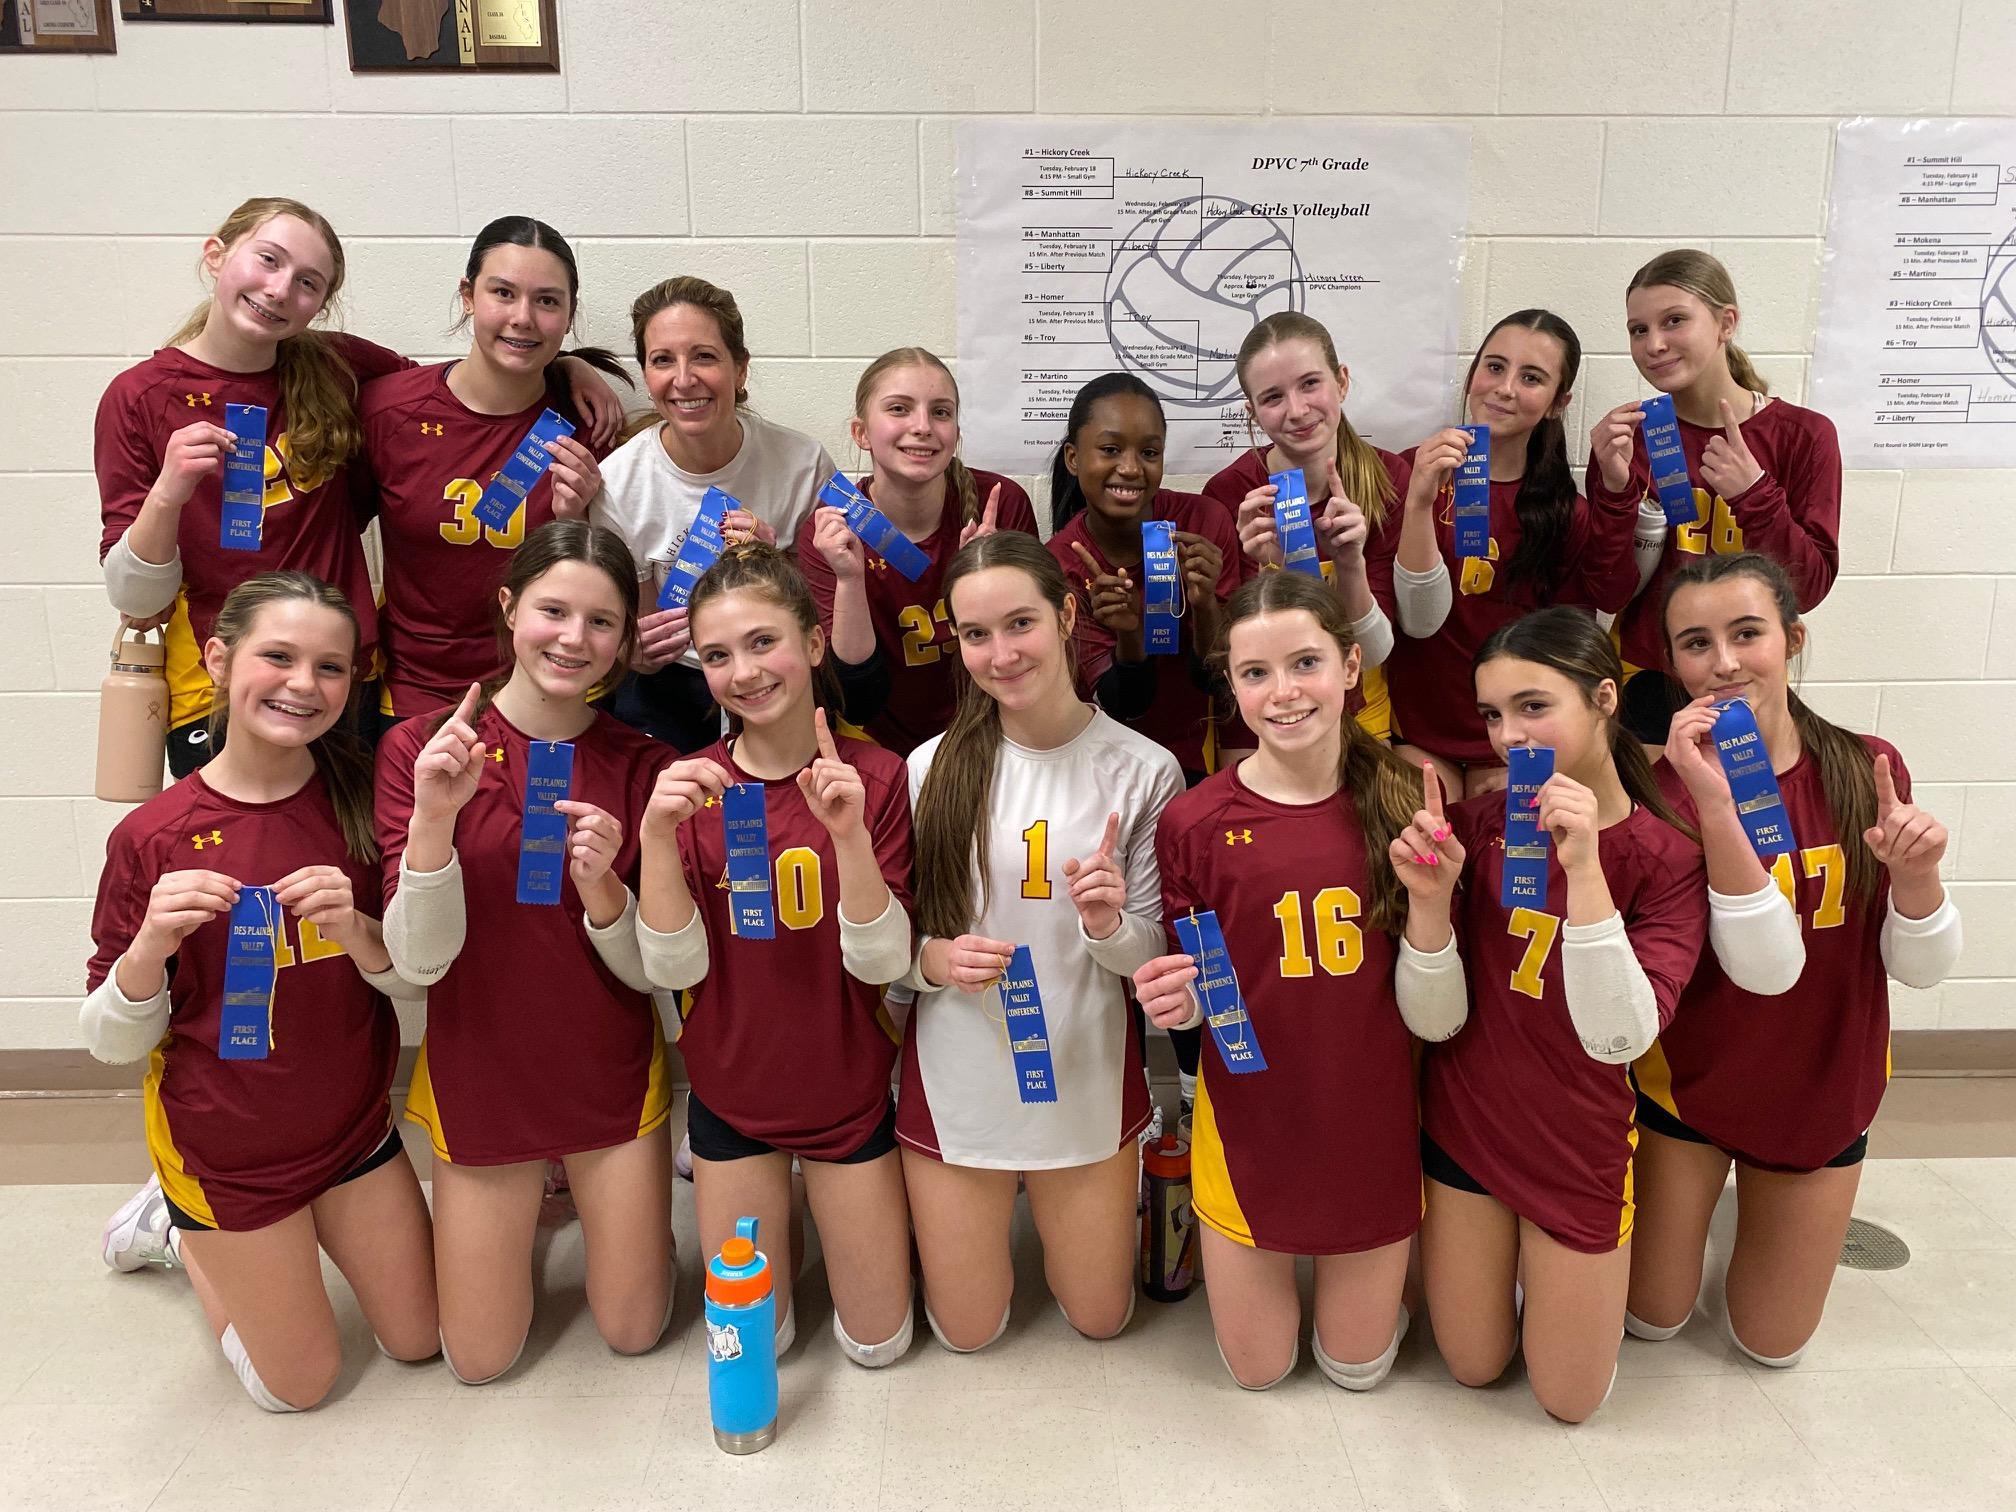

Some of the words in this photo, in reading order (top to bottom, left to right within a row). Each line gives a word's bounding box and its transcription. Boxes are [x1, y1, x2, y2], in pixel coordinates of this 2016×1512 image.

[1251, 157, 1297, 171] DPVC
[1300, 157, 1318, 171] 7th
[1322, 157, 1369, 171] Grade
[1250, 203, 1288, 218] Girls
[1292, 203, 1370, 218] Volleyball
[1024, 334, 1033, 342] #6
[1040, 334, 1056, 342] Troy
[1647, 428, 1656, 437] DES
[1656, 423, 1676, 435] PLAINES
[1655, 435, 1672, 446] VALLEY
[528, 446, 545, 460] VALLEY
[1651, 446, 1680, 459] CONFERENCE
[516, 451, 542, 473] CONFERENCE
[1467, 454, 1487, 463] PLAINES
[1463, 466, 1481, 475] VALLEY
[1457, 478, 1487, 486] CONFERENCE
[489, 497, 506, 512] FIRST
[231, 519, 252, 528] FIRST
[1280, 519, 1309, 532] CONFERENCE
[1676, 487, 1745, 556] 26
[230, 528, 252, 538] PLACE
[1153, 563, 1169, 571] VALLEY
[1459, 537, 1499, 596] 6
[672, 584, 690, 596] FIRST
[1153, 628, 1170, 636] FIRST
[1152, 636, 1171, 644] PLACE
[1719, 738, 1732, 751] DES
[1732, 731, 1758, 747] PLAINES
[1731, 749, 1755, 762] VALLEY
[1729, 760, 1768, 779] CONFERENCE
[530, 777, 542, 787] DES
[543, 778, 568, 788] PLAINES
[1511, 783, 1523, 793] DES
[537, 791, 558, 801] VALLEY
[727, 820, 739, 829] DES
[739, 818, 763, 829] PLAINES
[1755, 824, 1779, 836] FIRST
[736, 834, 757, 843] VALLEY
[1757, 833, 1783, 845] PLACE
[729, 846, 765, 857] CONFERENCE
[1021, 819, 1052, 900] 1
[1514, 876, 1536, 885] FIRST
[1770, 843, 1846, 929] 17
[1512, 885, 1537, 895] PLACE
[742, 908, 763, 917] FIRST
[742, 918, 765, 927] PLACE
[234, 925, 247, 935] DES
[1273, 886, 1364, 978] 16
[240, 941, 265, 951] VALLEY
[1507, 907, 1561, 1000] 7
[1012, 979, 1034, 989] PLAINES
[1198, 975, 1234, 992] CONFERENCE
[1010, 993, 1030, 1003] VALLEY
[1007, 1006, 1040, 1017] CONFERENCE
[233, 1025, 257, 1034] FIRST
[230, 1036, 258, 1045] PLACE
[1230, 1051, 1254, 1061] PLACE
[1025, 1070, 1044, 1079] FIRST
[1026, 1080, 1047, 1089] PLACE
